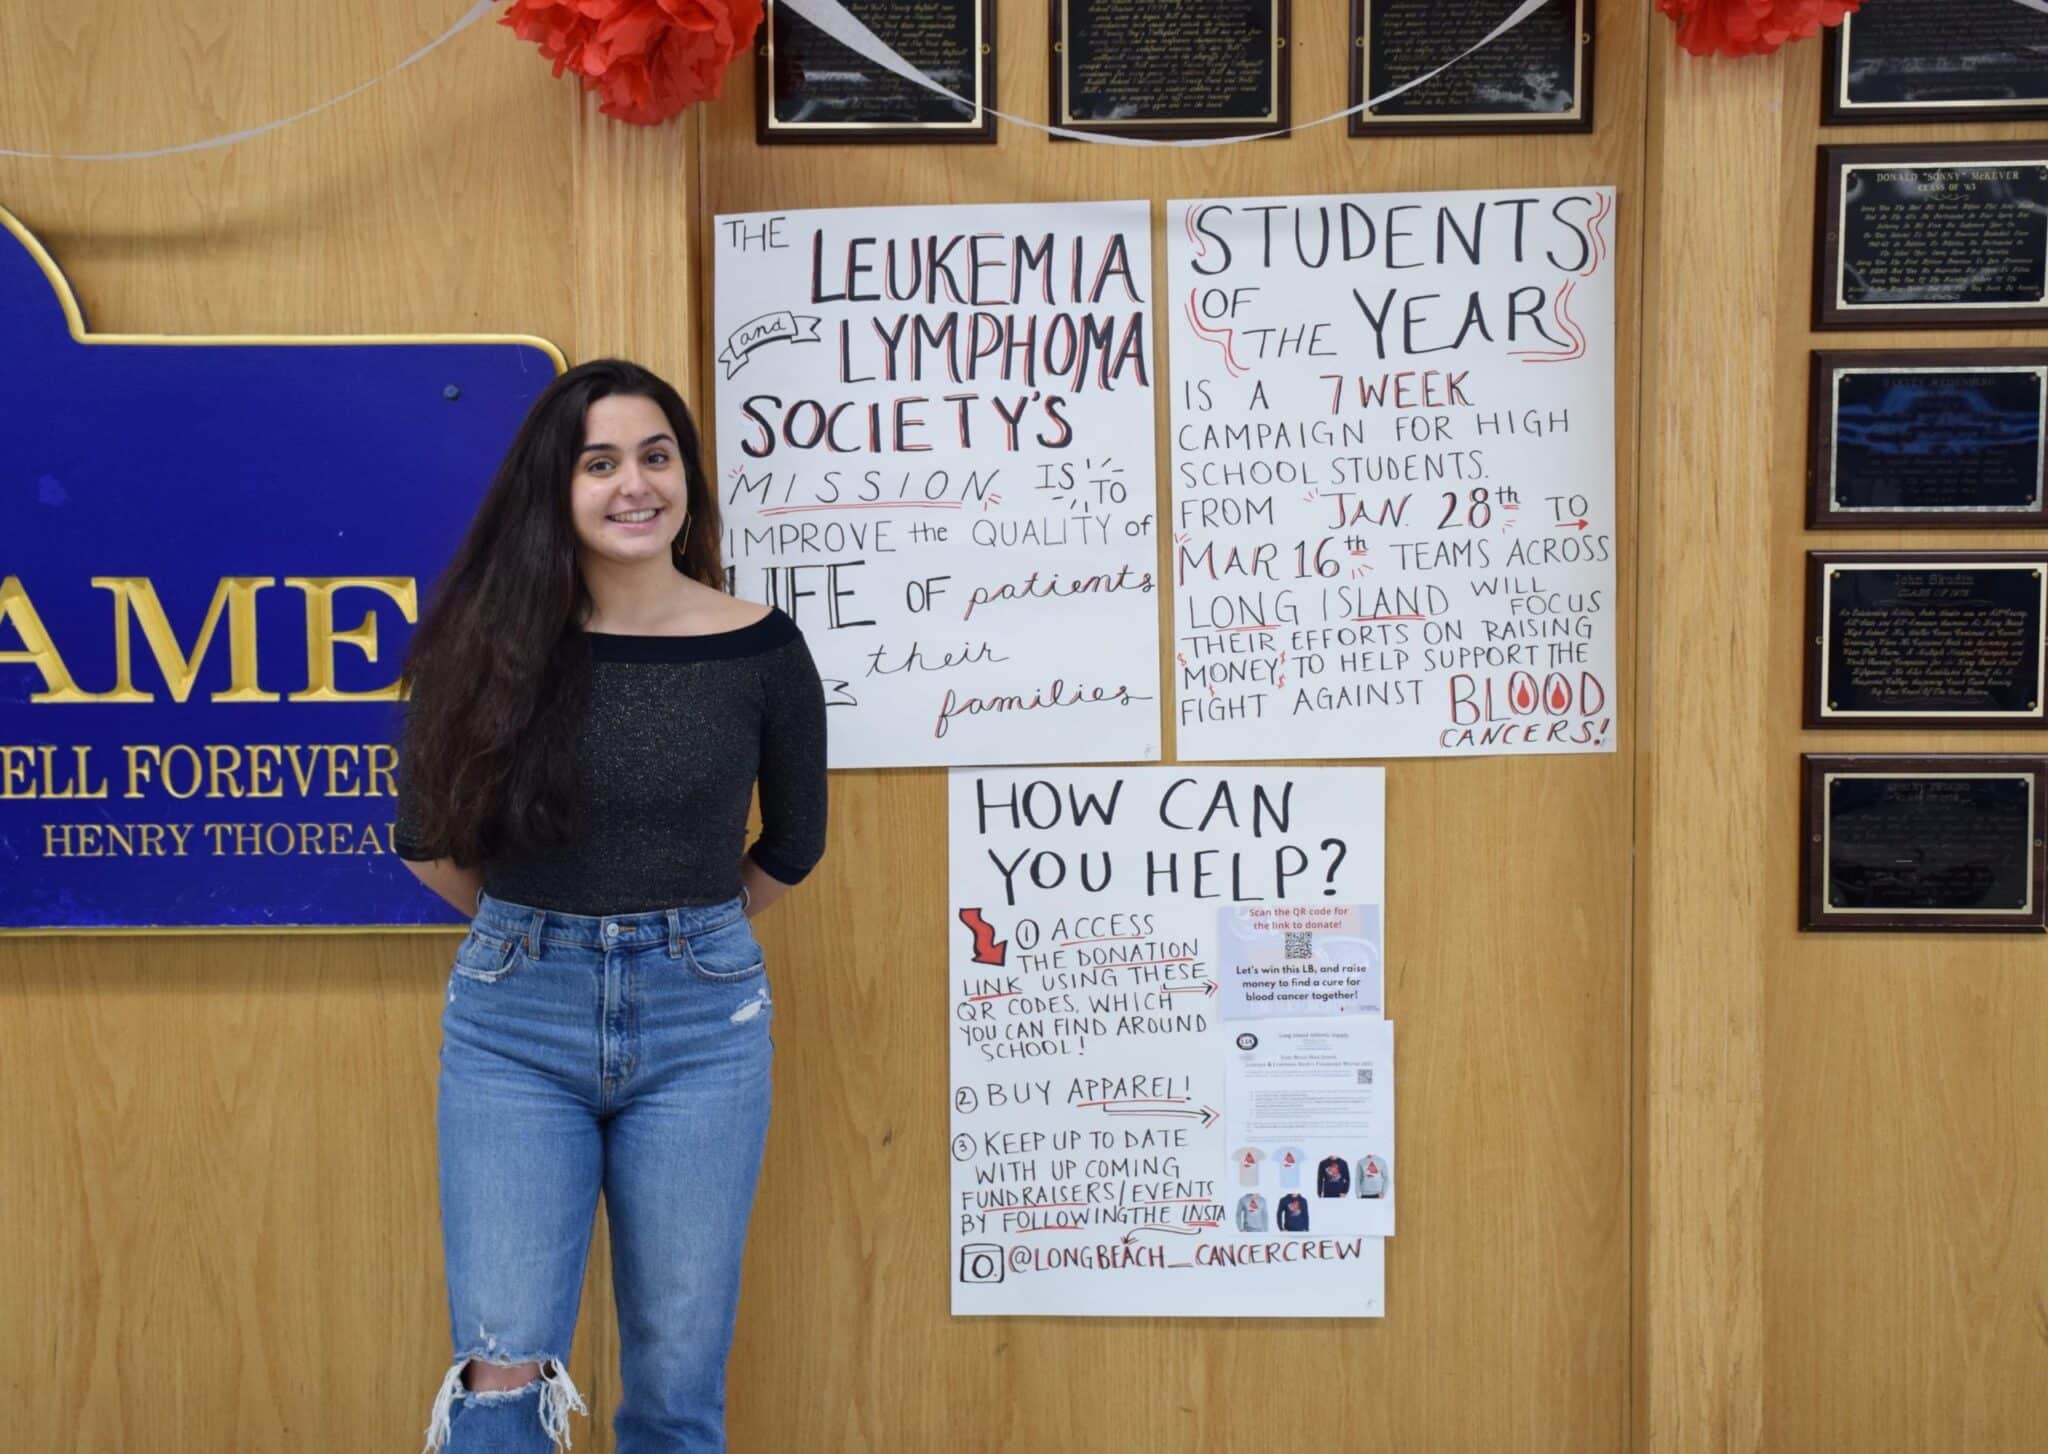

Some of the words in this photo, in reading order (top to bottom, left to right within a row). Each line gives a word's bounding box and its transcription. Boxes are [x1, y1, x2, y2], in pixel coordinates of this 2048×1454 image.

[1191, 196, 1592, 275] STUDENTS
[722, 217, 791, 251] THE
[811, 229, 1145, 306] LEUKEMIA
[1202, 288, 1260, 319] OF
[1242, 323, 1338, 360] THE
[1352, 285, 1571, 360] YEAR
[740, 318, 787, 346] and
[840, 311, 1149, 393] LYMPHOMA
[1185, 379, 1213, 410] IS
[1249, 380, 1270, 410] A
[1319, 374, 1344, 415] 7
[1358, 370, 1475, 410] WEEK
[740, 391, 1074, 458] SOCIETY'S
[1178, 419, 1365, 451] CAMPAIGN
[1396, 414, 1453, 443] FOR
[1476, 409, 1569, 437] HIGH
[729, 469, 1001, 504] MISSION
[1035, 463, 1075, 490] IS
[1089, 479, 1127, 504] TO
[1180, 458, 1318, 489] SCHOOL
[1331, 450, 1490, 483] STUDENTS.
[1181, 496, 1275, 530] FROM
[1436, 486, 1521, 531] 28th
[1544, 495, 1589, 521] TO
[729, 520, 897, 558] IMPROVE
[908, 521, 948, 544] the
[972, 514, 1114, 546] QUALITY
[1125, 514, 1153, 539] of
[1178, 541, 1280, 586] MAR
[1294, 535, 1369, 582] 16th
[1390, 538, 1491, 571] TEAMS
[1505, 535, 1611, 568] ACROSS
[906, 576, 951, 613] OF
[963, 564, 1156, 621] patients
[1189, 590, 1299, 630] LONG
[1322, 584, 1450, 620] ISLAND
[1470, 577, 1548, 597] WILL
[1510, 590, 1602, 616] FOCUS
[1181, 632, 1276, 658] THEIR
[1291, 624, 1410, 650] EFFORTS
[1423, 620, 1463, 645] ON
[1481, 616, 1594, 642] RAISING
[866, 641, 1009, 678] their
[1184, 657, 1281, 690] MONEY
[1291, 654, 1326, 679] TO
[1340, 649, 1410, 673] HELP
[1424, 644, 1539, 672] SUPPORT
[1546, 641, 1590, 669] THE
[934, 679, 1153, 739] families
[1181, 693, 1268, 726] FIGHT
[1292, 679, 1424, 715] AGAINST
[1448, 671, 1606, 727] BLOOD
[1440, 718, 1610, 749] CANCERS!
[123, 744, 400, 799] FOREVER
[976, 778, 1124, 834] HOW
[1159, 777, 1295, 838] CAN
[42, 823, 195, 857] HENRY
[987, 847, 1113, 906] YOU
[1146, 837, 1348, 902] HELP?
[1050, 913, 1155, 941] ACCESS
[1249, 908, 1272, 917] Scan
[1274, 908, 1290, 916] the
[1293, 907, 1306, 916] QR
[1309, 907, 1331, 916] code
[1334, 907, 1349, 915] for
[1253, 921, 1270, 930] the
[1272, 921, 1290, 929] link
[1305, 920, 1342, 929] donate!
[1016, 953, 1065, 975] THE
[1077, 938, 1199, 967] DONATION
[1236, 966, 1258, 975] Let's
[1260, 966, 1280, 974] win
[1282, 965, 1300, 974] this
[1319, 964, 1339, 973] and
[1342, 964, 1367, 973] raise
[963, 976, 1023, 997] LINK
[1042, 969, 1119, 992] USING
[1132, 962, 1208, 985] THESE
[1242, 980, 1276, 990] money
[1279, 980, 1289, 988] to
[1291, 978, 1311, 987] find
[1322, 979, 1344, 987] cure
[1346, 977, 1361, 986] for
[1246, 992, 1274, 1001] blood
[1276, 992, 1309, 1001] cancer
[1311, 990, 1358, 1002] together!
[957, 999, 998, 1023] QR
[1090, 991, 1173, 1013] WHICH
[959, 1024, 1000, 1044] YOU
[1006, 1021, 1044, 1041] CAN
[1054, 1015, 1106, 1038] FIND
[1116, 1014, 1208, 1035] AROUND
[980, 1037, 1085, 1062] SCHOOL!
[987, 1080, 1052, 1107] BUY
[1067, 1075, 1192, 1103] APPAREL!
[984, 1129, 1044, 1156] KEEP
[1053, 1130, 1081, 1151] UP
[1091, 1130, 1115, 1150] TO
[1125, 1127, 1188, 1148] DATE
[975, 1158, 1037, 1184] WITH
[962, 1180, 1215, 1210] FUNDRAISERS/EVENTS
[961, 1214, 991, 1235] BY
[1003, 1206, 1125, 1233] FOLLOWING
[1124, 1204, 1171, 1225] THE
[1183, 1204, 1226, 1223] INSTA
